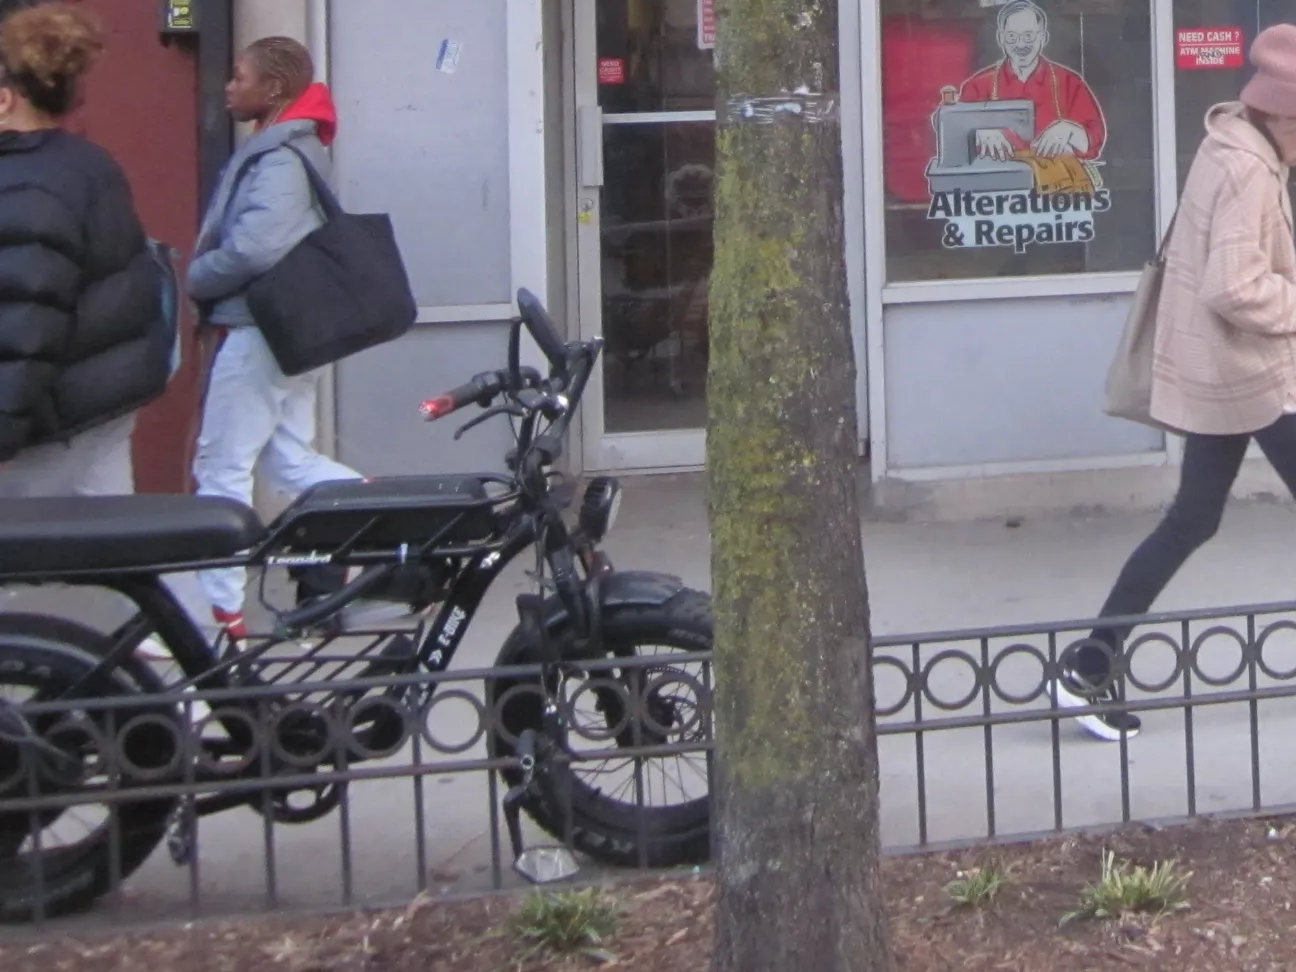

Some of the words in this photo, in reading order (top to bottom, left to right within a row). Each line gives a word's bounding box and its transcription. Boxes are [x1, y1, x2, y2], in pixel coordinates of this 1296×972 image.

[1178, 32, 1204, 42] NEED
[1206, 31, 1232, 42] CASH
[1180, 47, 1199, 56] ATM
[928, 185, 1110, 217] Alterations
[944, 222, 965, 247] &
[975, 214, 1094, 253] Repairs
